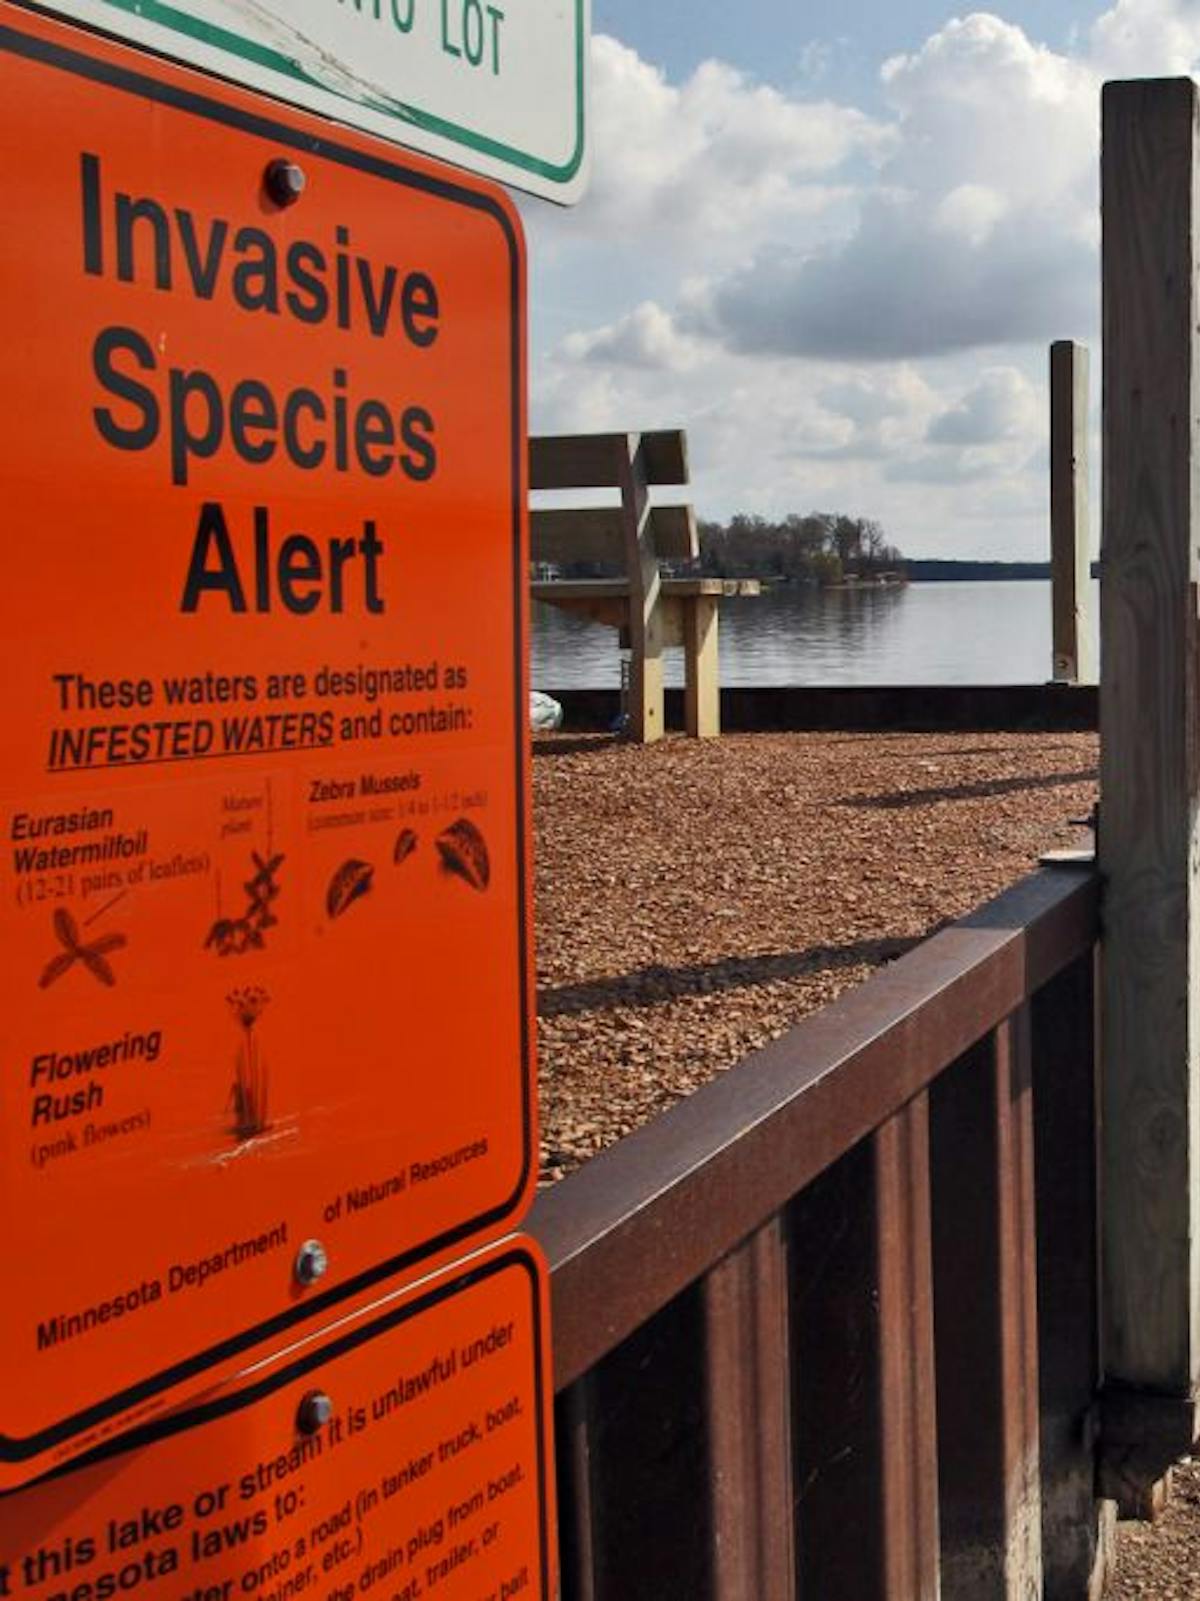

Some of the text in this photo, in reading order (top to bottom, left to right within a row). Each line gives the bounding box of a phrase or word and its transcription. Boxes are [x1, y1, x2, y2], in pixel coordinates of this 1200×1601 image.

[442, 0, 504, 75] LOT
[80, 151, 440, 349] Invasive
[92, 325, 438, 486] Species
[180, 502, 386, 614] Alert
[53, 661, 468, 711] These waters are designated as
[47, 705, 473, 771] INFESTED WATERS and contain:
[310, 770, 422, 802] Zebra Mussels
[11, 806, 114, 842] Eurasian
[14, 830, 148, 874] Watermilfoil
[30, 1030, 163, 1089] Flowering
[31, 1081, 104, 1128] Rush
[31, 1132, 78, 1171] (pink
[36, 1136, 489, 1351] Minnesota Department of Natural Resources
[21, 1537, 97, 1587] this
[107, 1502, 184, 1553] lake
[193, 1484, 230, 1518] or
[239, 1433, 323, 1502] stream
[328, 1416, 343, 1448] it
[347, 1408, 366, 1436] is
[371, 1350, 456, 1422] unlawful
[461, 1322, 513, 1369] under
[191, 1508, 267, 1562] laws
[275, 1485, 305, 1522] to:
[241, 1549, 291, 1593] onto
[294, 1538, 306, 1559] a
[310, 1500, 351, 1548] road
[355, 1489, 378, 1523] (in
[381, 1452, 434, 1500] tanker
[359, 1546, 403, 1593] drain
[406, 1519, 444, 1564] plug
[448, 1490, 484, 1528] from
[482, 1522, 500, 1548] or
